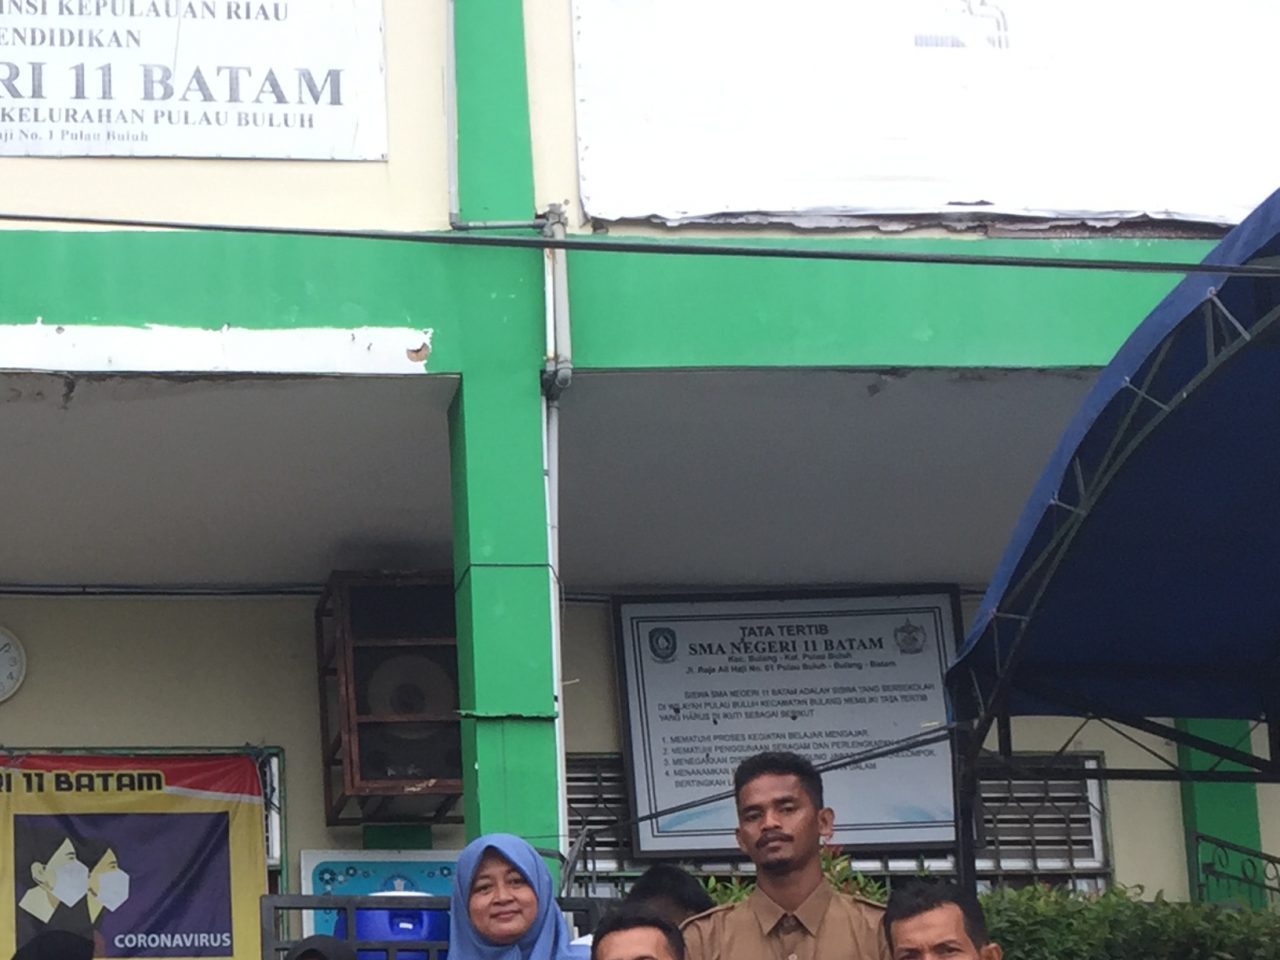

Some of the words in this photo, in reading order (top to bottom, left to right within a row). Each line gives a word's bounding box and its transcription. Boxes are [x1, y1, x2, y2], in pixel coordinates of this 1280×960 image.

[58, 0, 217, 19] KEPULAUAN
[226, 1, 289, 21] RIAU
[69, 62, 115, 100] 11
[139, 64, 344, 106] BATAM
[1, 106, 144, 124] KELURAHAN
[154, 108, 229, 127] PULAU
[237, 111, 314, 129] BULUH
[20, 129, 42, 141] No.
[740, 626, 771, 638] TATA
[777, 624, 829, 637] TERTIB
[689, 643, 726, 656] SMA
[730, 638, 797, 654] NEGERI
[803, 640, 817, 652] 11
[823, 637, 885, 652] BATAM
[22, 772, 45, 793] 11
[54, 772, 163, 793] BATAM
[114, 932, 232, 948] CORONAVIRUS
